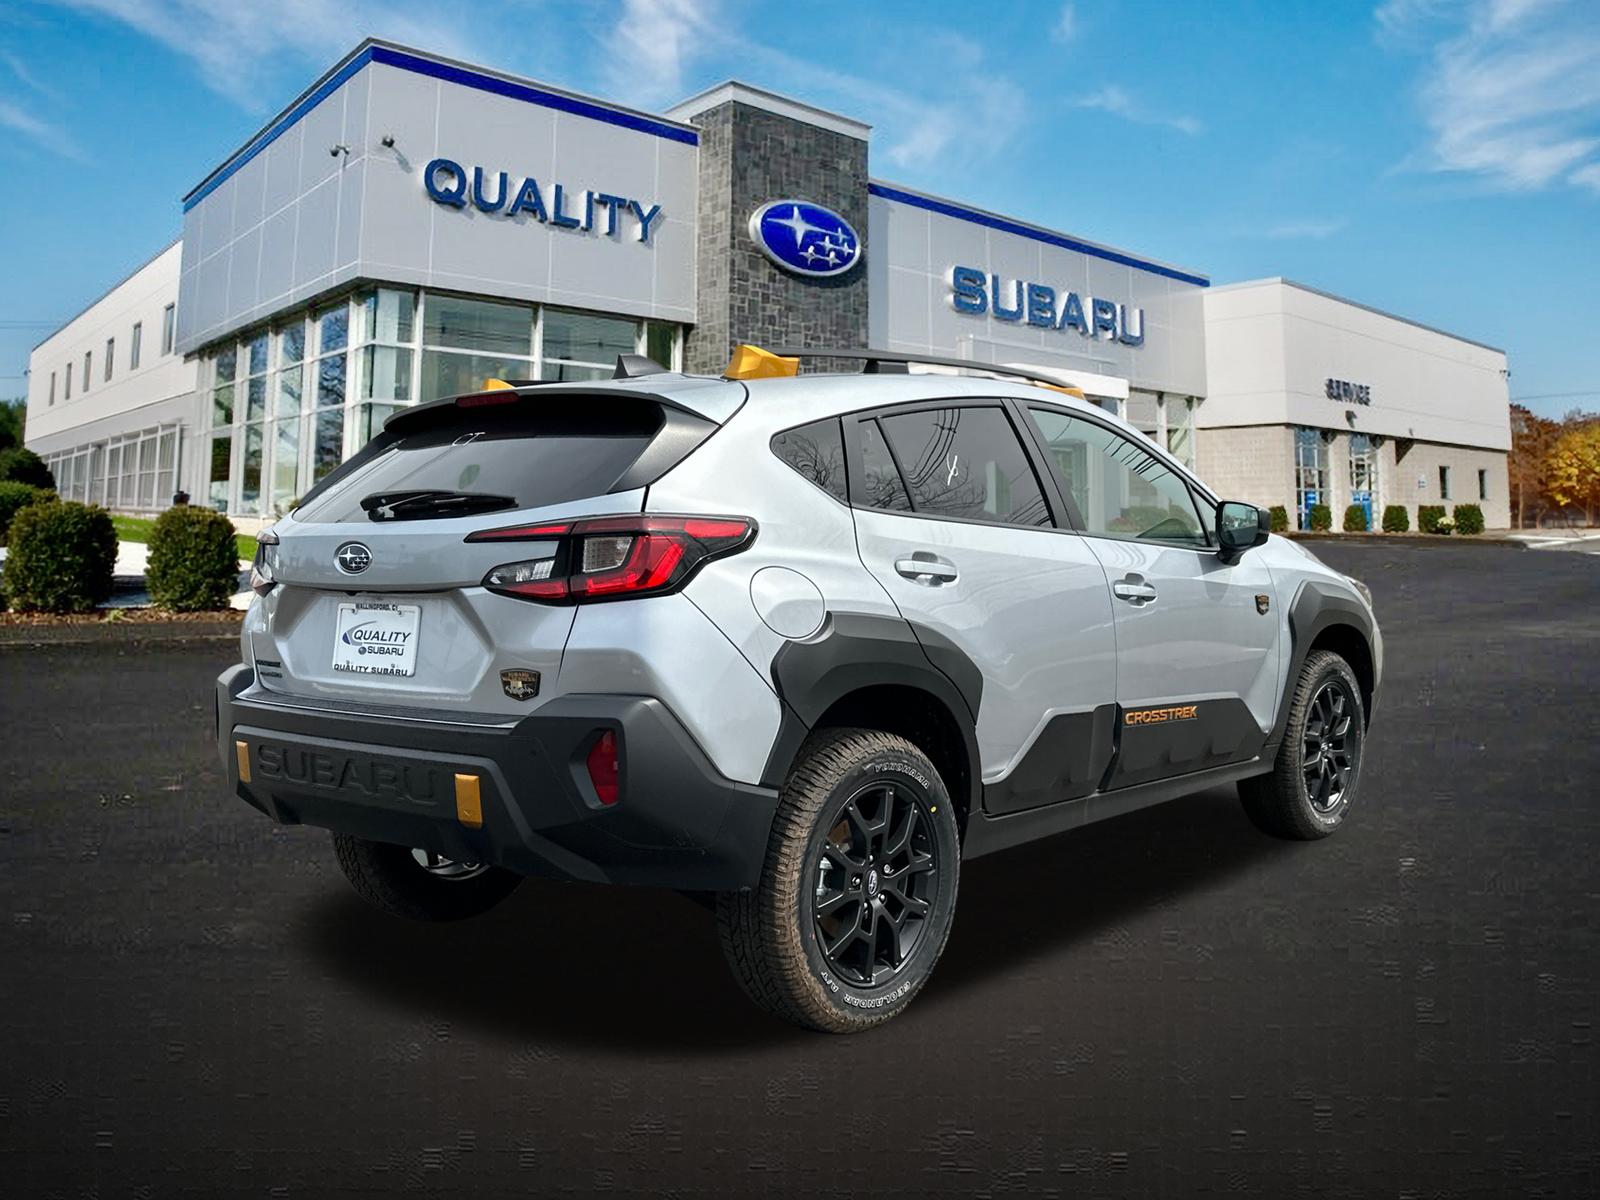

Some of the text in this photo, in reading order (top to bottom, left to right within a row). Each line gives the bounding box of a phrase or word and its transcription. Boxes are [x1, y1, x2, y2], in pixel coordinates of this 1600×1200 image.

[422, 157, 661, 243] QUALITY
[950, 265, 1145, 346] SUBARU
[1325, 377, 1371, 407] SERVICE
[353, 629, 412, 643] QUALITY
[367, 645, 405, 656] SUBARU
[333, 662, 408, 677] QUALITY SUBARU
[1125, 705, 1198, 726] CROSSTREK
[257, 744, 437, 806] SUBARU
[875, 762, 930, 789] YOKOHAMA
[821, 972, 911, 1008] GEOLANDAR A/T
